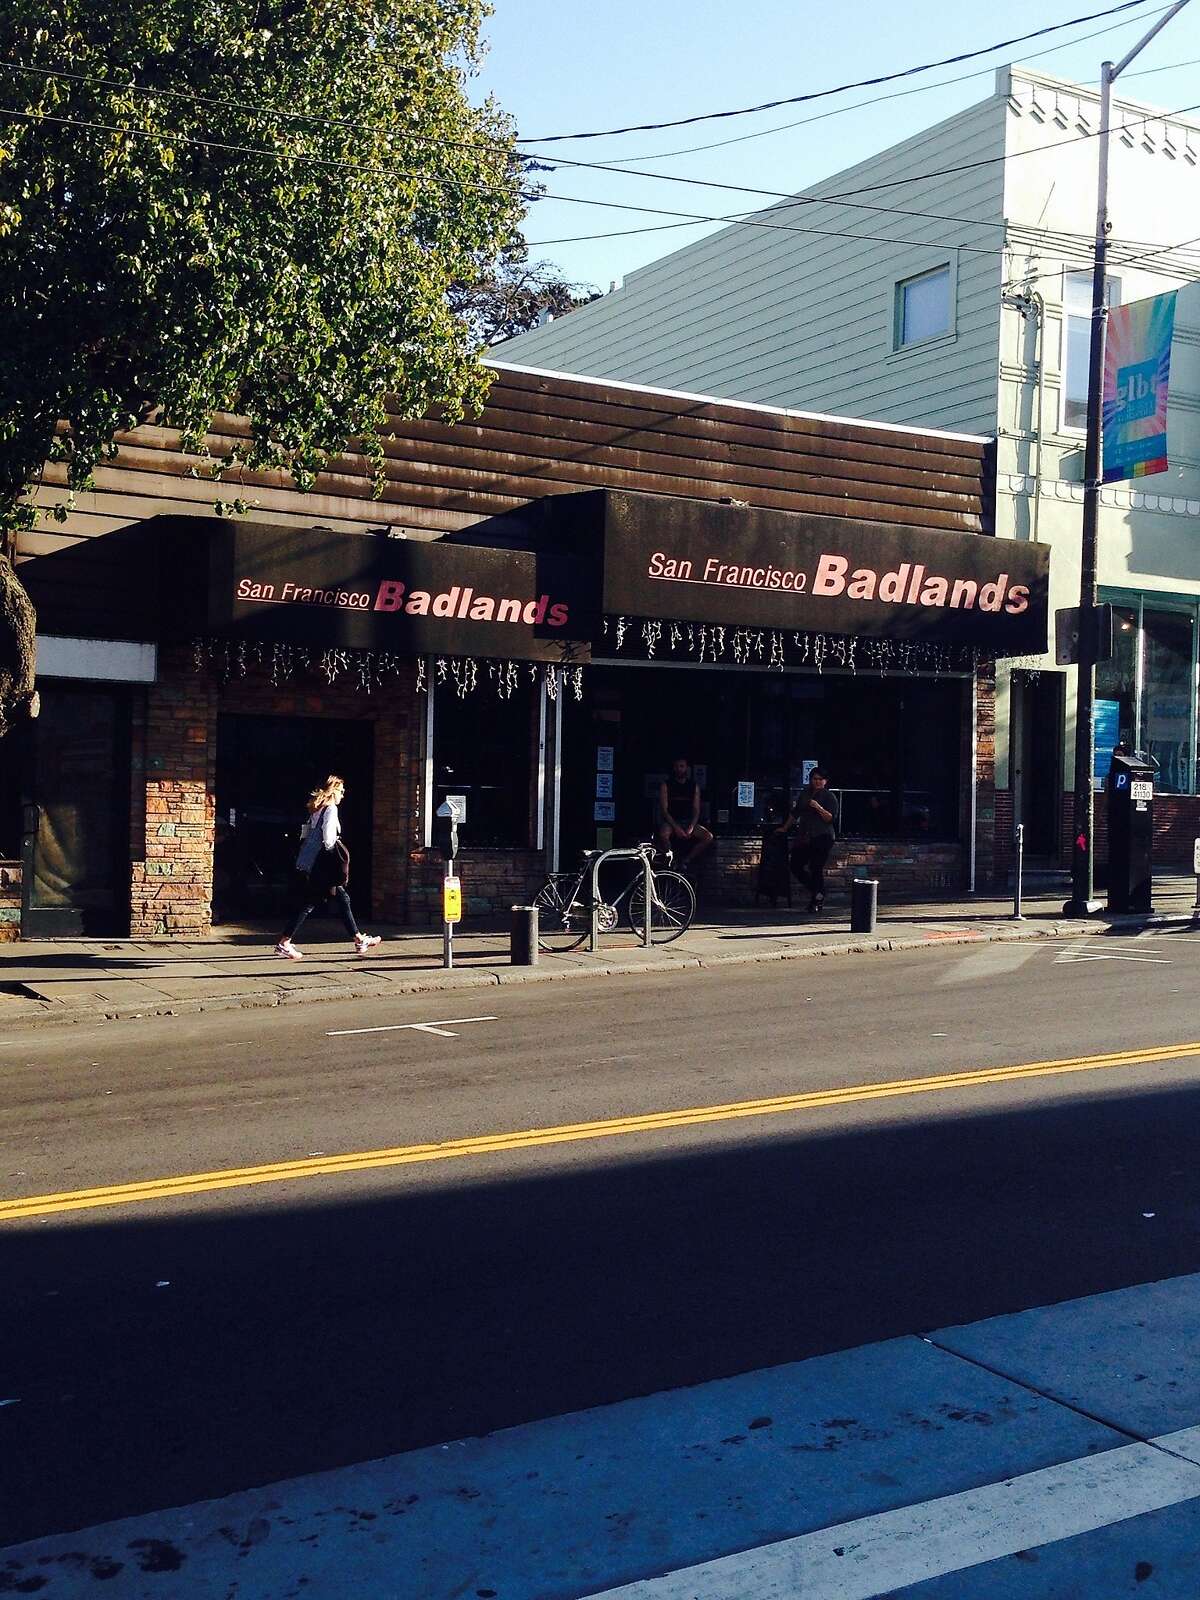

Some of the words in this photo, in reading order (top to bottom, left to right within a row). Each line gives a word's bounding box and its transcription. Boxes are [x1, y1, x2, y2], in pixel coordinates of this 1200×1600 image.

[237, 579, 275, 600] San
[281, 582, 370, 608] Francisco
[373, 580, 569, 627] Badlands
[648, 552, 693, 578] San
[702, 557, 808, 591] Francisco
[811, 554, 1031, 615] Badlands
